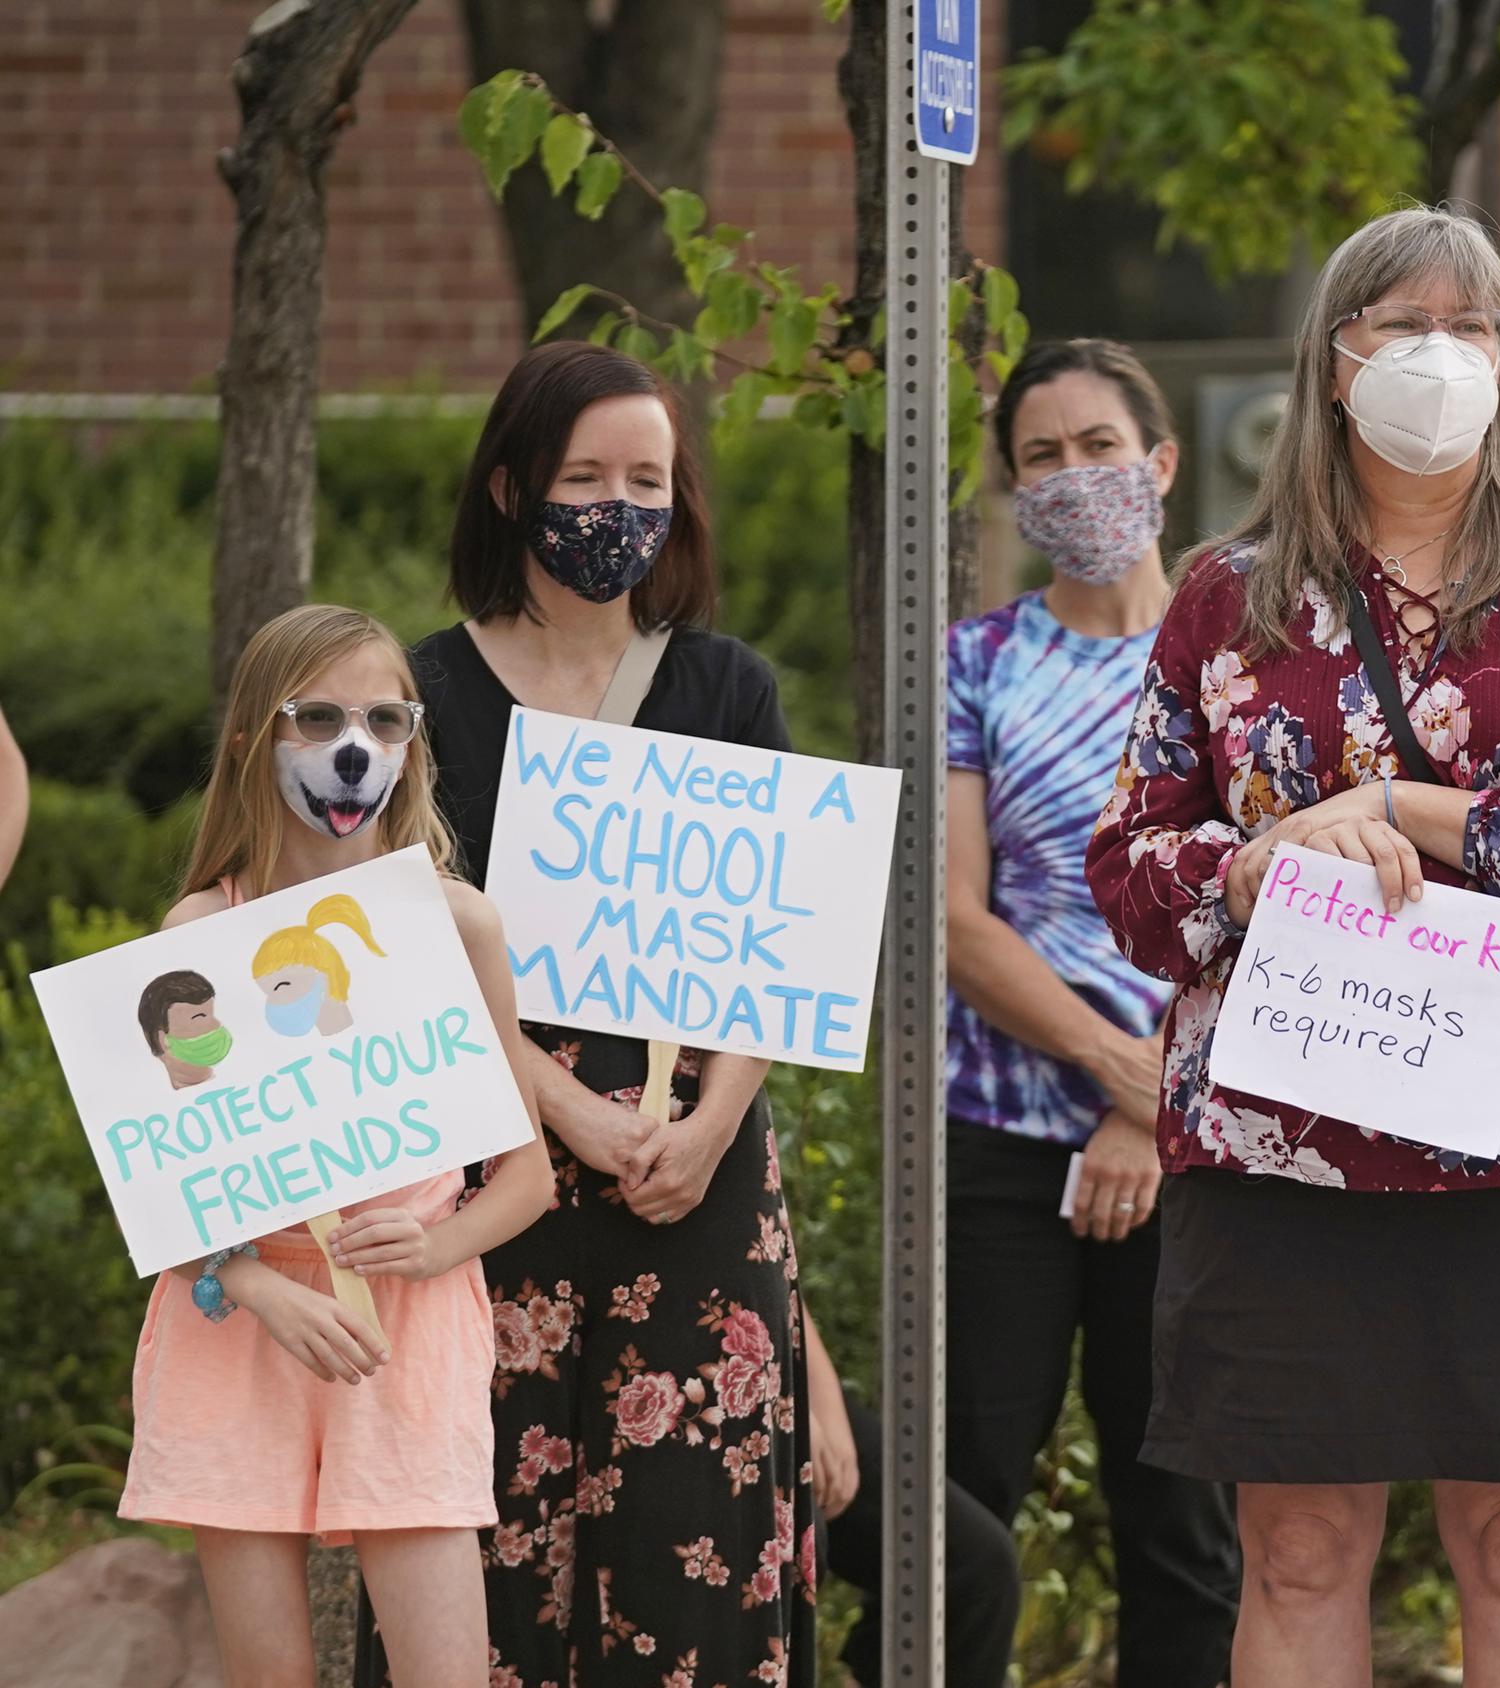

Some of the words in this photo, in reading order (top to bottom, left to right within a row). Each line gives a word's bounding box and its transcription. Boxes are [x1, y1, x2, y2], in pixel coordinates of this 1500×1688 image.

[515, 713, 610, 789] We
[632, 742, 782, 814] Need
[809, 772, 855, 823] A
[530, 794, 816, 916] SCHOOL
[1265, 858, 1396, 939] Protect
[1407, 924, 1467, 958] our
[575, 896, 788, 971] MASK
[507, 944, 860, 1059] MANDATE
[1247, 948, 1321, 994] K-6
[1341, 978, 1465, 1037] masks
[1252, 1001, 1432, 1068] required
[105, 1055, 319, 1182] PROTECT
[328, 1006, 488, 1098] YOUR
[179, 1099, 441, 1247] FRIENDS
